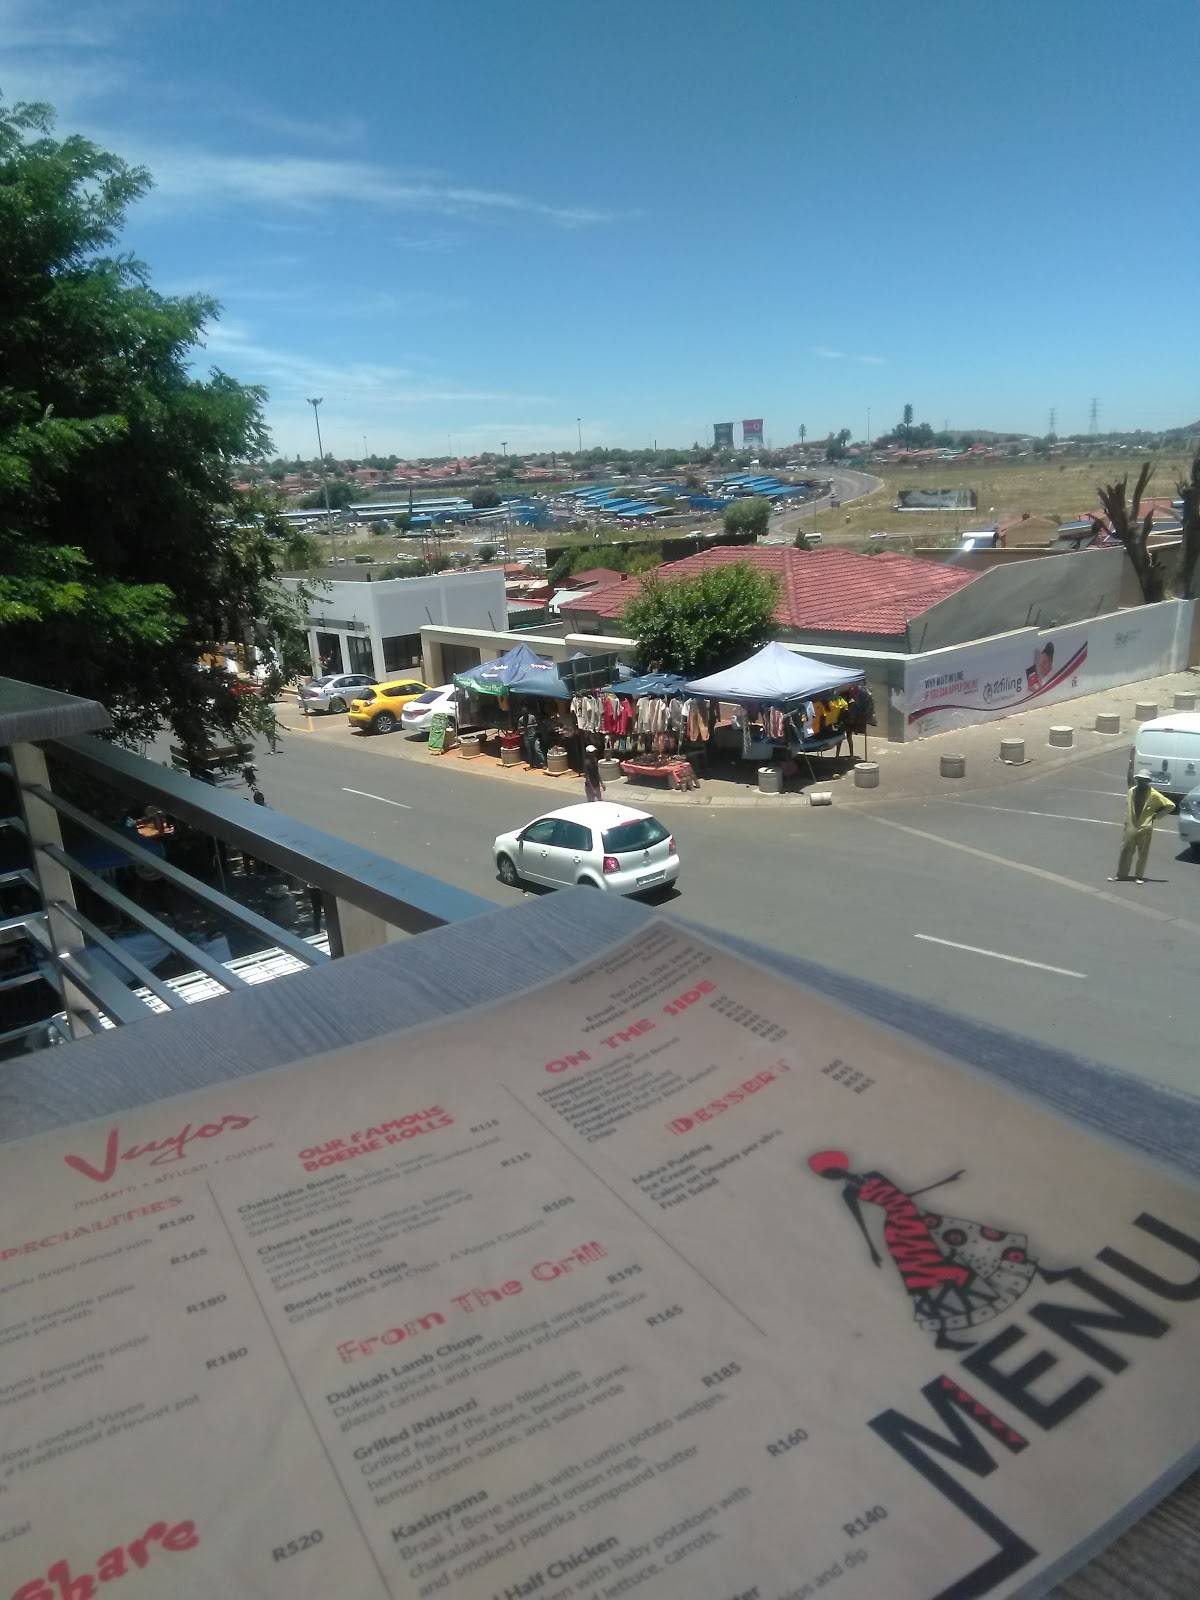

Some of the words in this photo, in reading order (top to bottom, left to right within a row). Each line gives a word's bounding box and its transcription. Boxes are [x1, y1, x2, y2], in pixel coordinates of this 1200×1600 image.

[545, 1050, 591, 1073] ON
[600, 1018, 656, 1048] THE
[663, 979, 717, 1016] SIDE
[666, 1058, 791, 1137] DESSERT
[64, 1114, 259, 1183] Vuyos
[298, 1138, 347, 1160] OUR
[351, 1105, 445, 1143] FAMOUS
[303, 1138, 383, 1173] BOERIE
[385, 1114, 455, 1146] ROLLS
[73, 1183, 138, 1209] modern
[154, 1162, 208, 1185] african
[306, 1173, 347, 1191] Boerie
[541, 1195, 576, 1214] R105
[159, 1213, 196, 1231] R130
[309, 1217, 353, 1237] Boerie
[170, 1247, 209, 1266] R165
[607, 1264, 641, 1284] R195
[186, 1293, 228, 1315] R180
[284, 1291, 332, 1312] Boerie
[335, 1277, 367, 1293] with
[369, 1262, 407, 1279] Chips
[338, 1312, 444, 1361] From
[452, 1280, 522, 1311] The
[532, 1242, 607, 1281] Grill
[646, 1305, 683, 1326] R165
[326, 1374, 389, 1404] Dukkah
[391, 1354, 434, 1376] Lamb
[436, 1334, 482, 1356] Chops
[333, 1389, 388, 1417] Dukkah
[392, 1367, 436, 1392] spiced
[437, 1353, 471, 1372] lamb
[471, 1340, 503, 1356] with
[340, 1404, 386, 1432] glazed
[445, 1367, 470, 1385] and
[472, 1343, 532, 1372] rosemary
[534, 1320, 580, 1345] infused
[580, 1308, 612, 1324] lamb
[702, 1362, 740, 1387] R185
[867, 1212, 1200, 1490] MENU
[19, 1429, 103, 1472] traditional
[107, 1401, 171, 1437] drievoet
[174, 1392, 201, 1413] pot
[36, 1419, 94, 1450] cooked
[97, 1401, 146, 1425] Vuyos
[353, 1428, 409, 1459] Grilled
[412, 1398, 477, 1434] iNhlanzi
[360, 1446, 411, 1475] Grilled
[414, 1434, 441, 1450] fish
[444, 1423, 458, 1437] of
[462, 1415, 485, 1429] the
[489, 1401, 513, 1417] day
[516, 1383, 550, 1403] filled
[552, 1370, 581, 1387] with
[367, 1459, 423, 1491] herbed
[424, 1443, 461, 1464] baby
[531, 1382, 590, 1414] beetroot
[374, 1479, 424, 1506] lemon
[428, 1456, 472, 1481] cream
[525, 1418, 551, 1436] and
[552, 1403, 586, 1423] salsa
[587, 1384, 624, 1405] verde
[766, 1429, 808, 1456] R160
[392, 1491, 487, 1541] Kasinyama
[399, 1533, 442, 1560] Braai
[445, 1504, 502, 1536] T-Bone
[506, 1483, 546, 1507] steak
[548, 1465, 581, 1486] with
[583, 1443, 625, 1468] cumin
[628, 1419, 673, 1447] potato
[272, 1528, 325, 1564] R520
[410, 1533, 493, 1578] chakalaka,
[494, 1494, 560, 1534] battered
[563, 1474, 605, 1500] onion
[419, 1571, 450, 1598] and
[454, 1539, 516, 1579] smoked
[519, 1511, 576, 1547] paprika
[579, 1467, 654, 1513] compound
[655, 1446, 697, 1472] butter
[575, 1564, 612, 1591] with
[611, 1543, 651, 1570] baby
[654, 1506, 718, 1548] potatoes
[719, 1487, 751, 1509] with
[843, 1506, 887, 1537] R140
[504, 1571, 545, 1600] Half
[547, 1535, 619, 1579] Chicken
[815, 1562, 844, 1588] and
[844, 1548, 869, 1569] dip
